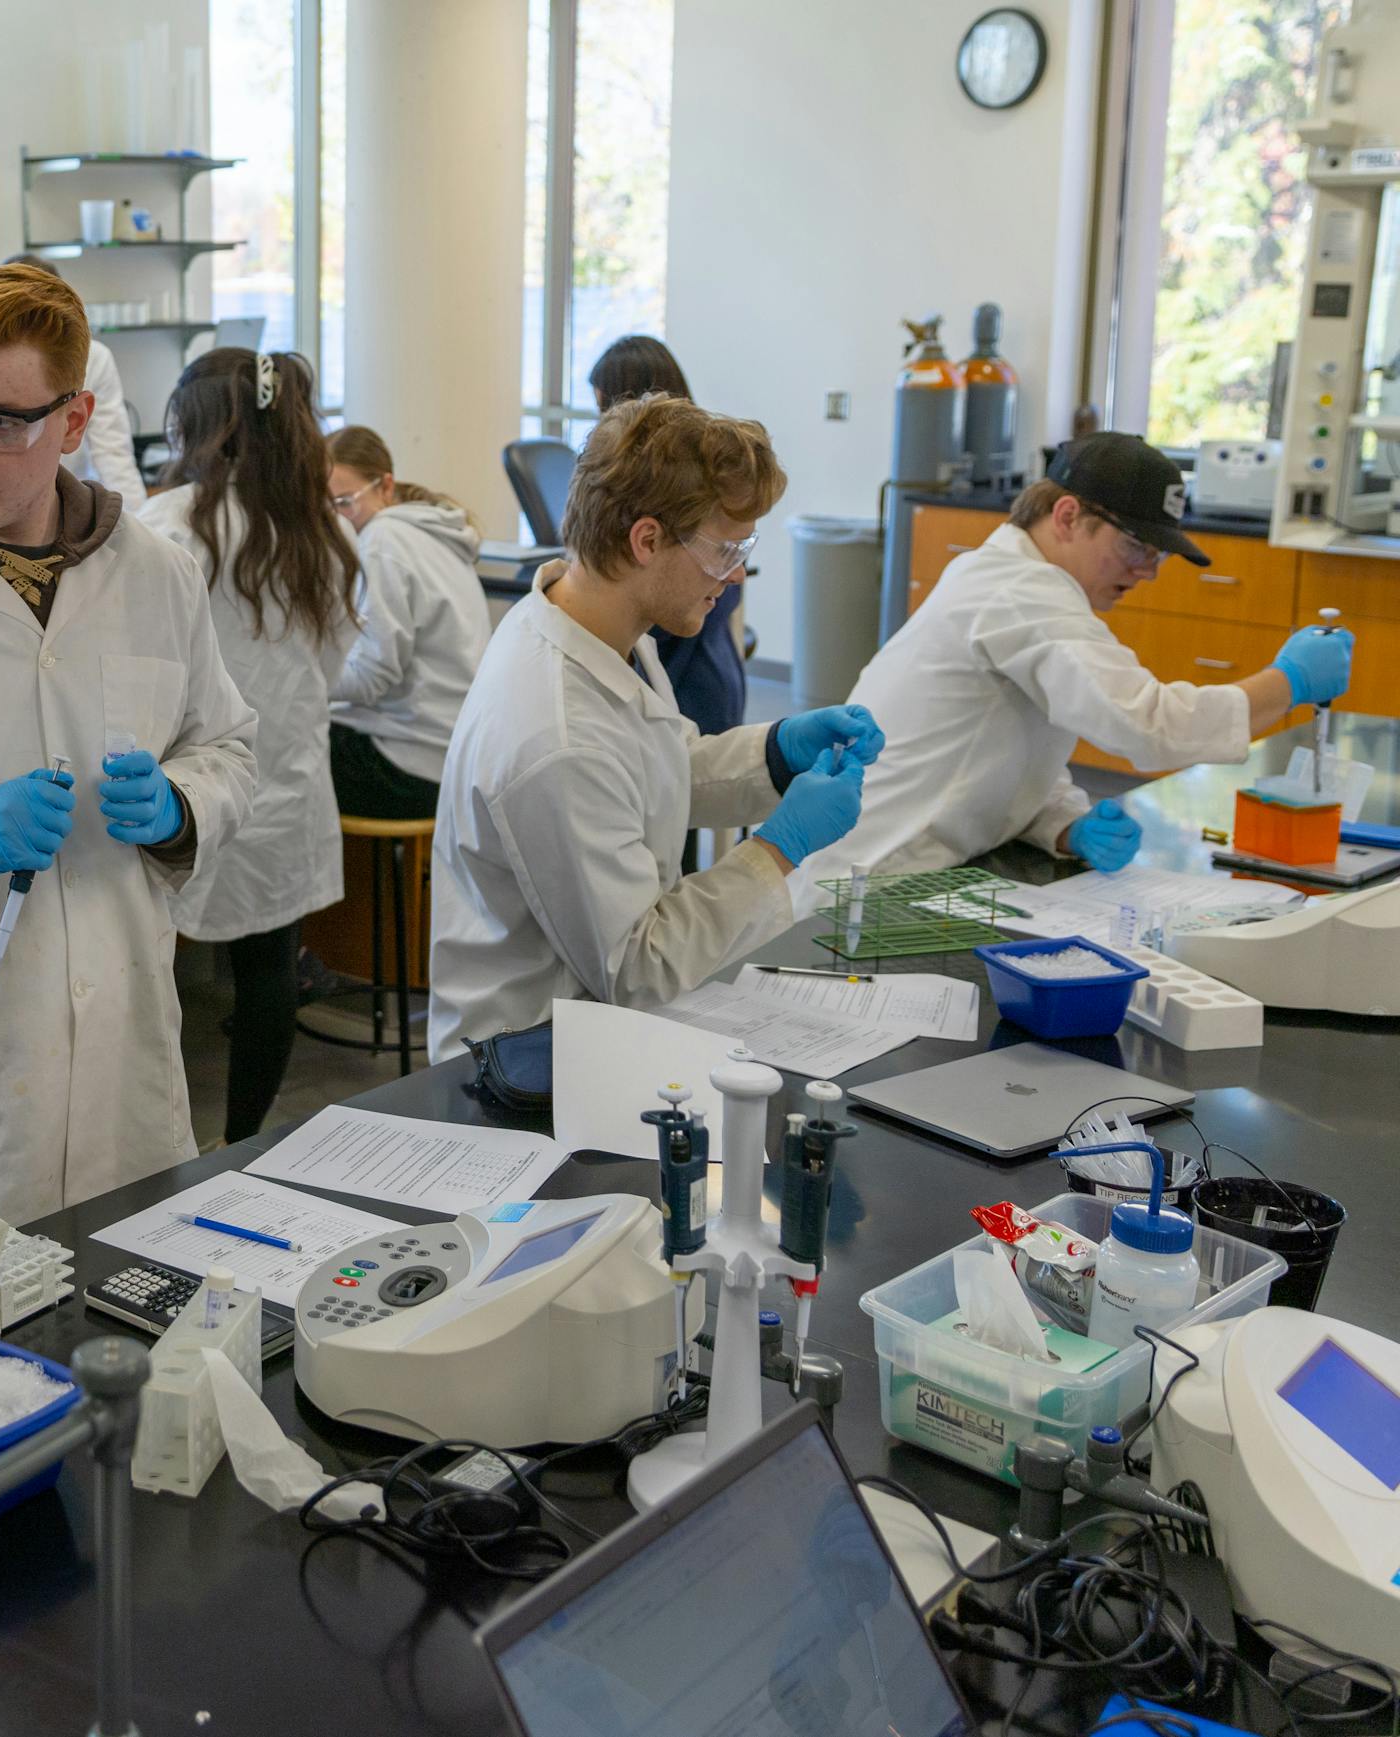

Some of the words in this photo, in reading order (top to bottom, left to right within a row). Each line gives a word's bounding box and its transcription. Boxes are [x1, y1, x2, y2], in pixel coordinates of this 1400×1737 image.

[1099, 1188, 1114, 1198] TIP
[1117, 1192, 1176, 1203] RECYNG
[916, 1388, 1005, 1436] KIMTECH
